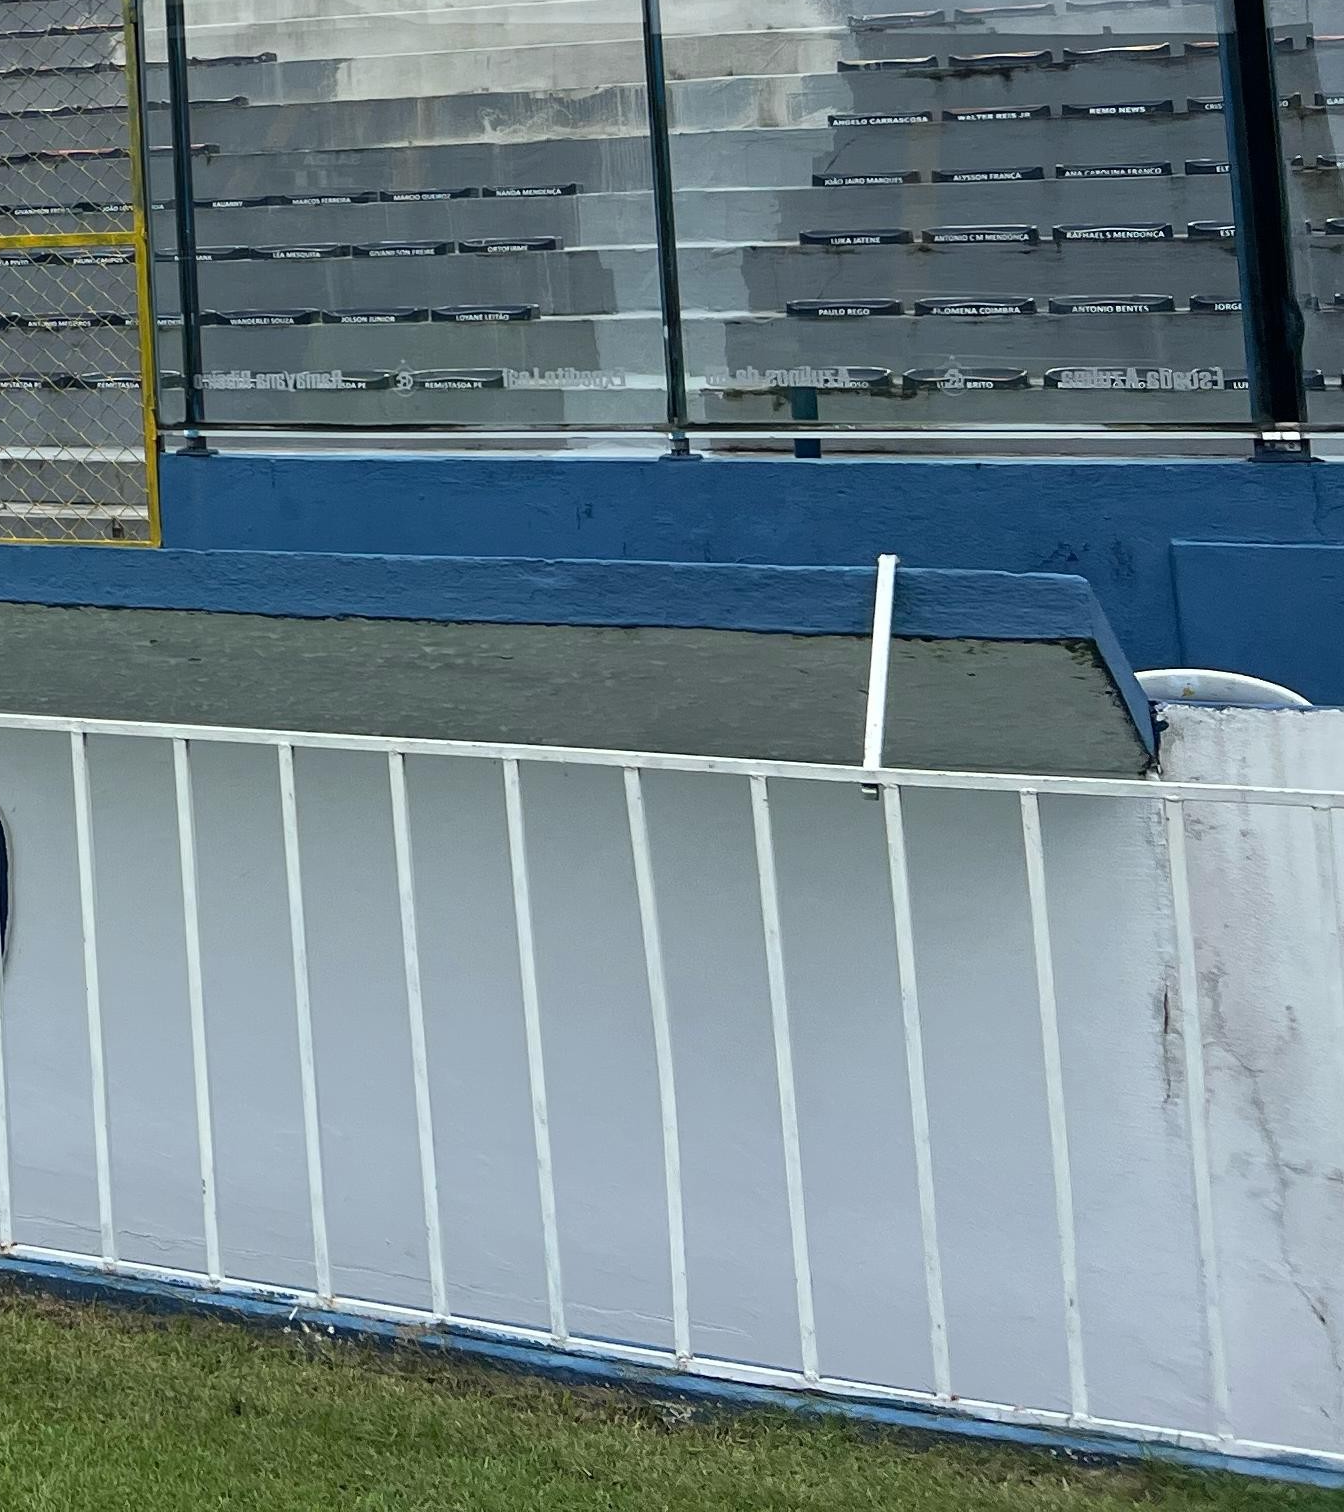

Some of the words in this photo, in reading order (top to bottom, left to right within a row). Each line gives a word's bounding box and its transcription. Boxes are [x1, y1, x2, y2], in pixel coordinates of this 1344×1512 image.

[1089, 106, 1116, 115] REMO
[1117, 105, 1146, 114] NEWS
[957, 113, 994, 122] WALTER
[995, 112, 1018, 121] REIS
[1018, 111, 1031, 120] JR
[832, 117, 868, 127] ANGELO
[952, 172, 988, 182] ALYSSON
[988, 171, 1022, 181] FRANÇA
[1064, 169, 1083, 178] ANA
[1083, 168, 1126, 177] CAROLINA
[824, 176, 843, 186] JOÃO
[866, 175, 903, 185] MARQUES
[495, 188, 521, 197] NANDA
[291, 197, 320, 207] MARCOS
[320, 196, 352, 206] FERREIRA
[933, 234, 968, 243] ANTONIO
[969, 234, 975, 242] C
[975, 234, 984, 242] M
[984, 232, 1029, 243] MENDONÇA
[1106, 231, 1112, 239] S
[1112, 229, 1165, 240] MENDONÇA
[852, 236, 881, 244] JATENE
[272, 250, 285, 260] LÉA
[285, 251, 321, 259] MESQUITA
[818, 307, 846, 317] PAULO
[846, 307, 870, 316] REGO
[978, 305, 1021, 315] COIMBRA
[1071, 304, 1114, 314] ANTONIO
[1115, 304, 1150, 313] BENTES
[229, 317, 270, 327] WANDERLEI
[270, 316, 295, 326] SOUZA
[368, 315, 396, 324] JUNIOR
[484, 313, 510, 322] LEITÃO
[967, 381, 994, 390] BRITO
